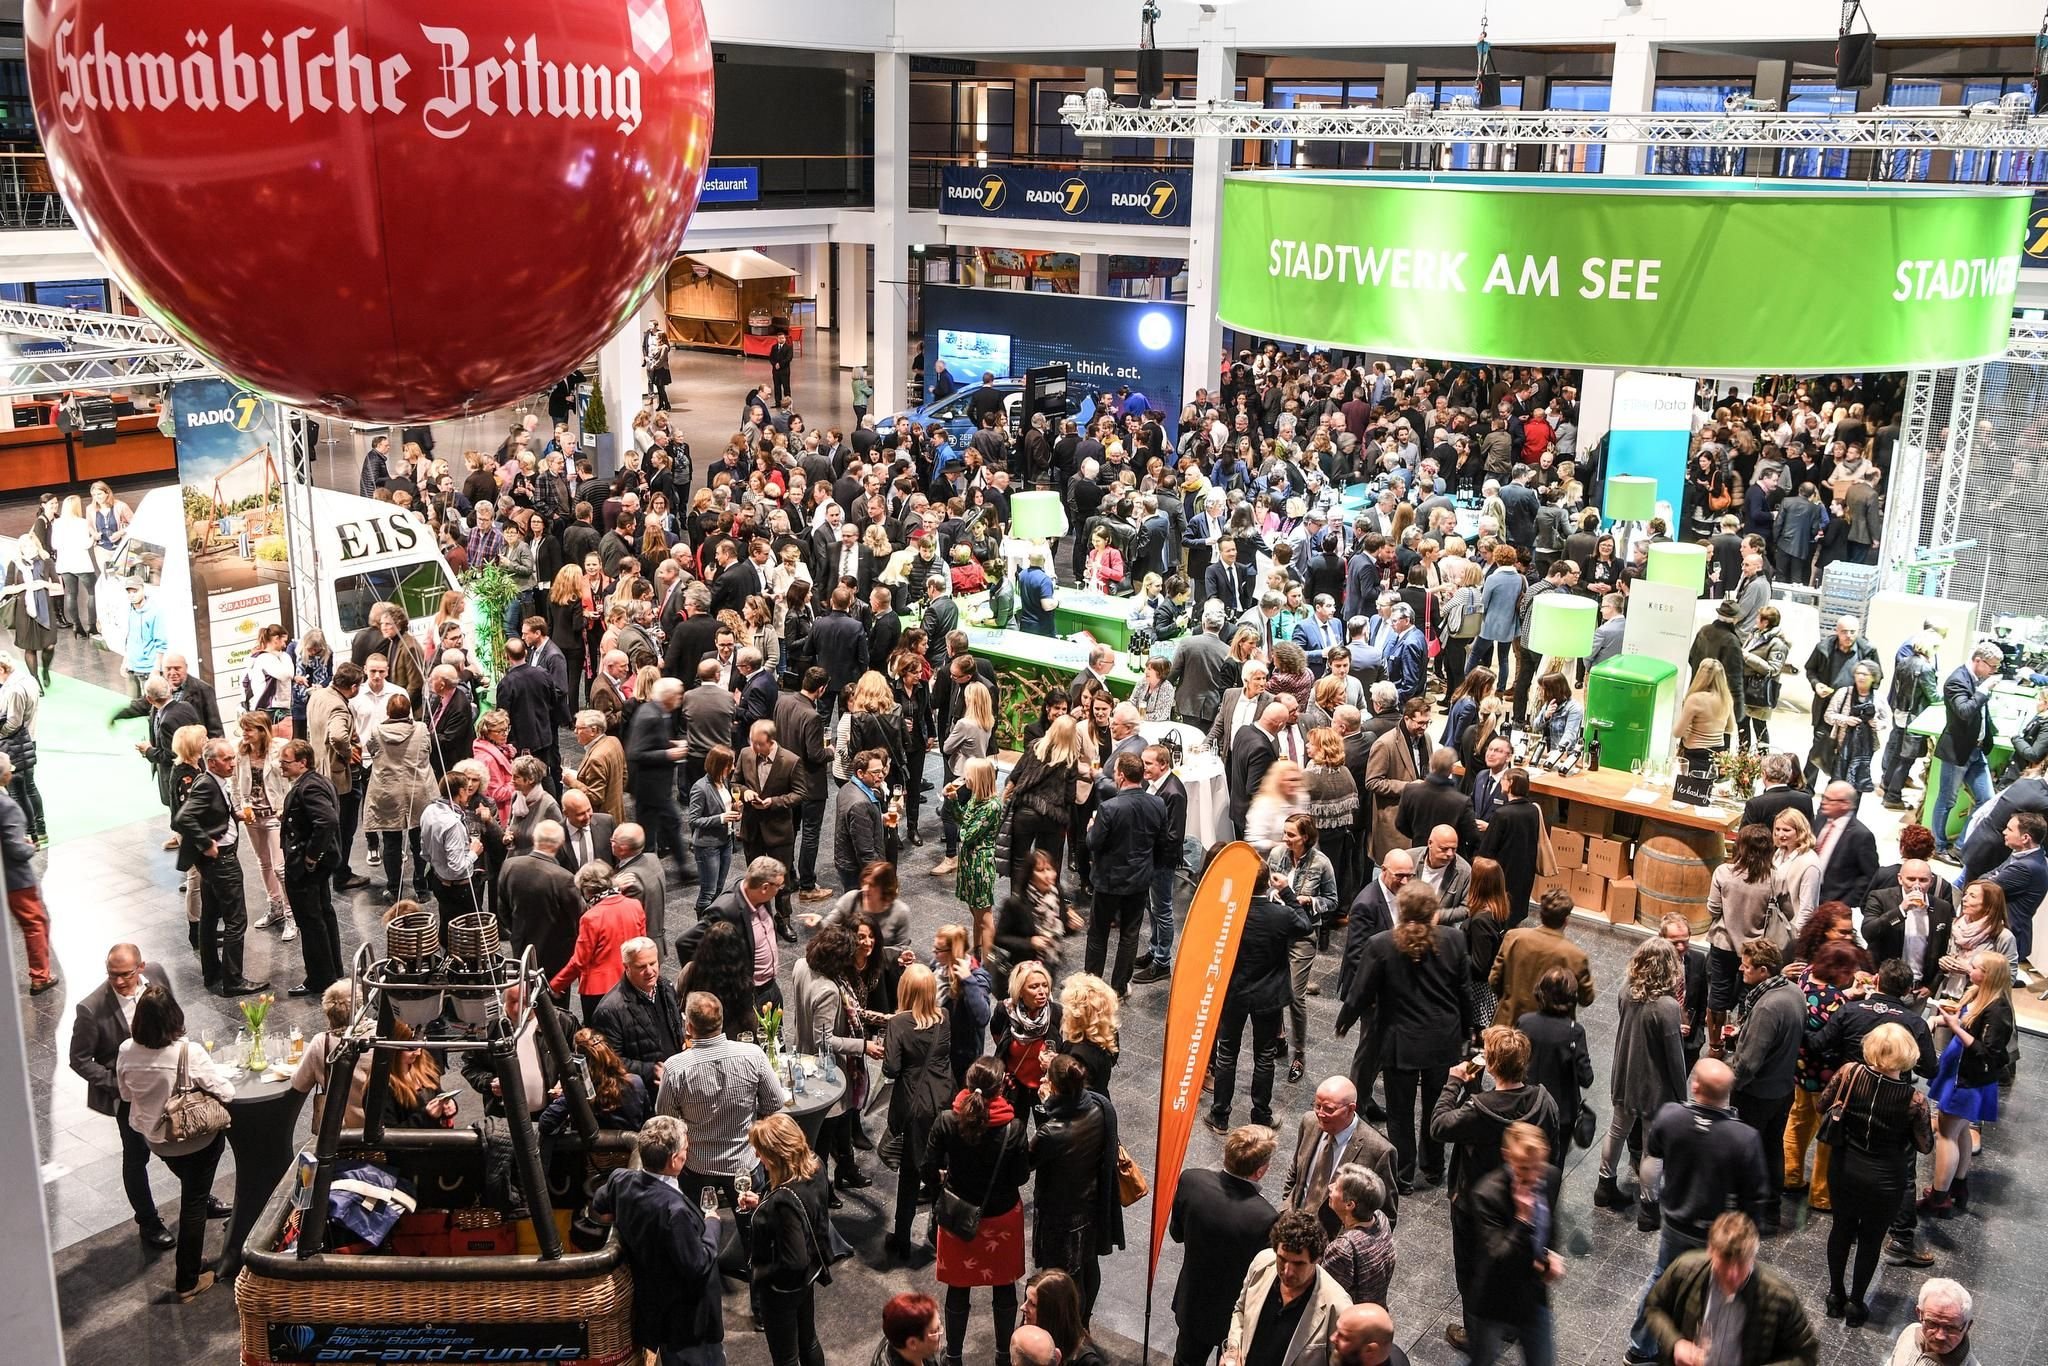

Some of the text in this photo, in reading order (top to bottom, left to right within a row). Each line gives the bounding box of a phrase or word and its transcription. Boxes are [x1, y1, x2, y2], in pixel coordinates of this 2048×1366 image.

[419, 22, 642, 139] Zeitung
[948, 181, 1003, 207] RADIO 7
[1026, 185, 1086, 211] RADIO 7
[1111, 187, 1175, 214] RADIO 7
[1268, 239, 1662, 301] STADTWERK AM SEE
[1077, 360, 1114, 376] think.
[1117, 366, 1141, 380] act.
[187, 398, 257, 429] RADIO 7
[336, 513, 417, 561] EIS
[228, 594, 271, 611] BAUHAUS
[1206, 900, 1237, 981] Zeitung
[325, 1335, 475, 1346] Allgäu-Bodensee
[331, 1326, 457, 1337] Ballonfahrten
[315, 1344, 582, 1361] air-and-fun.de
